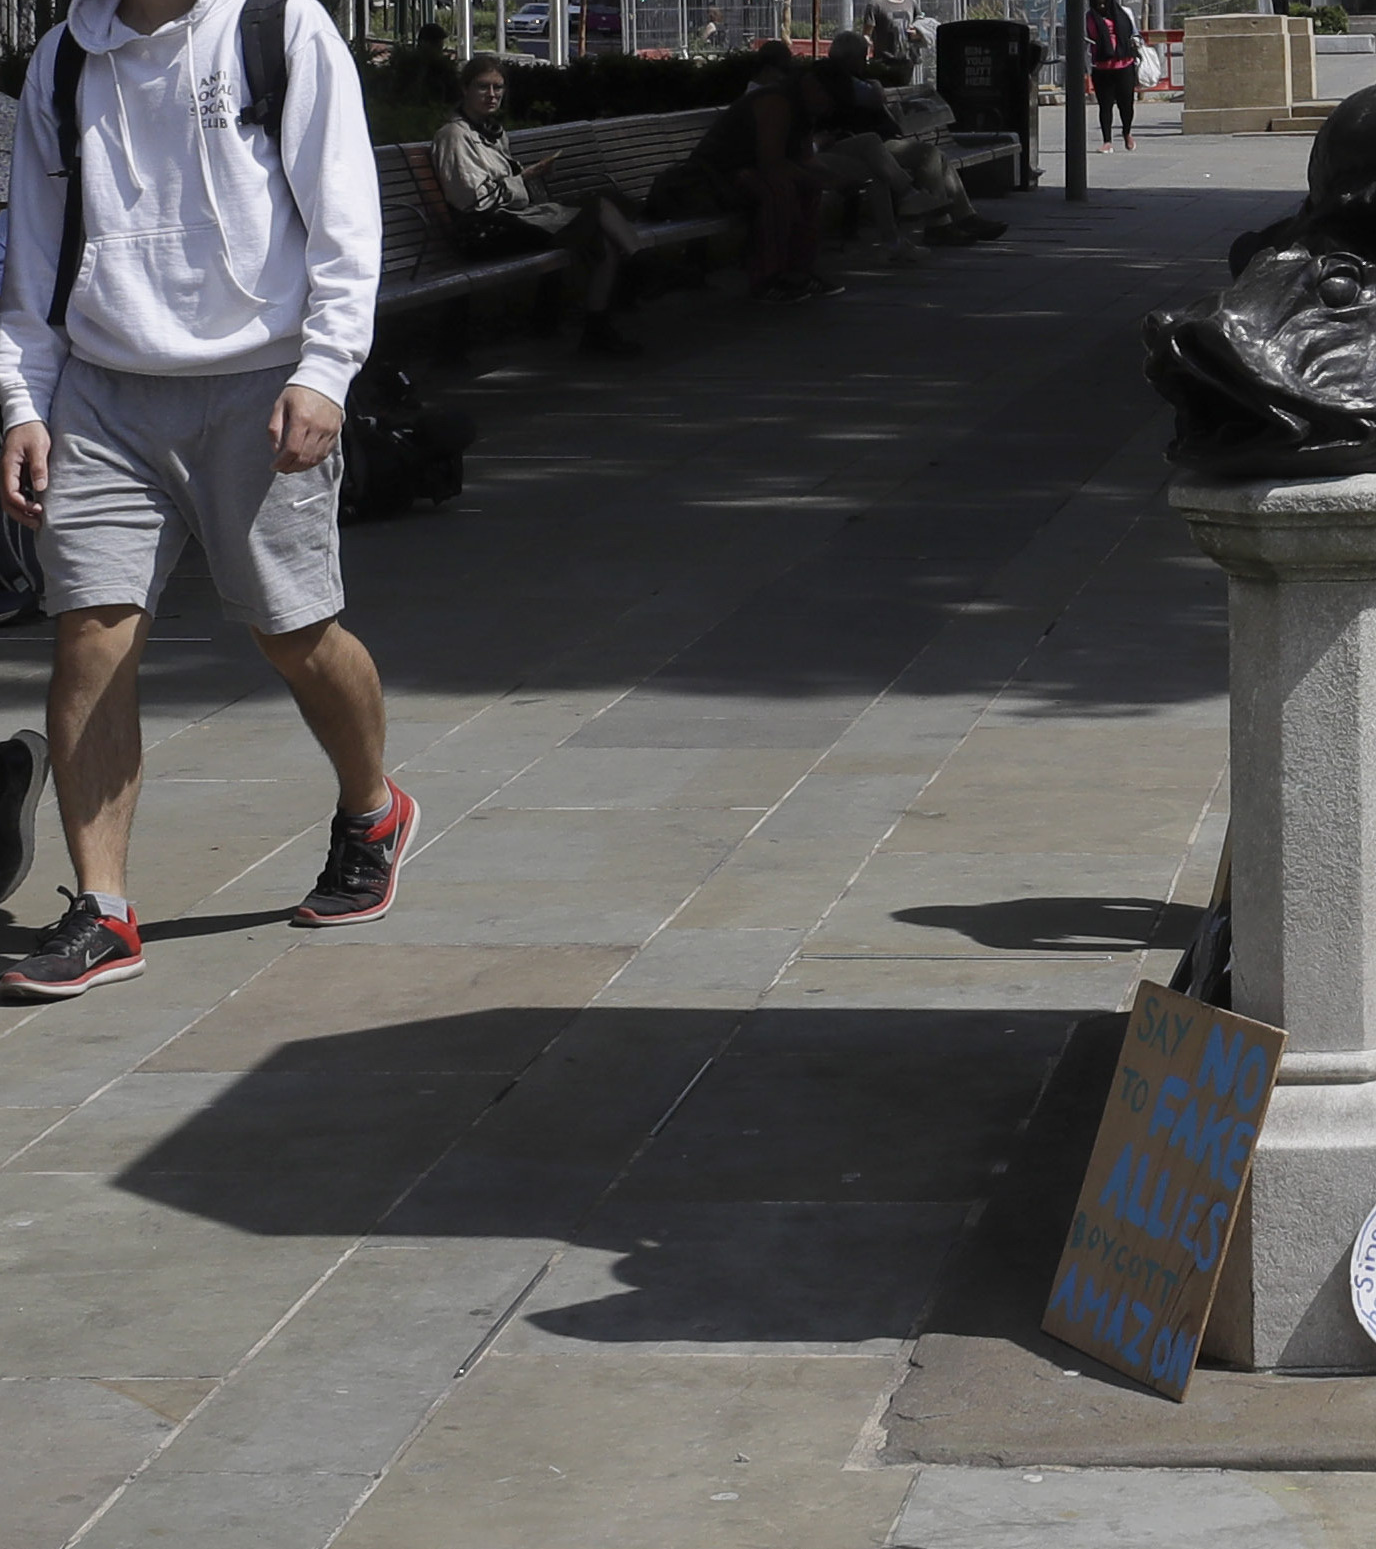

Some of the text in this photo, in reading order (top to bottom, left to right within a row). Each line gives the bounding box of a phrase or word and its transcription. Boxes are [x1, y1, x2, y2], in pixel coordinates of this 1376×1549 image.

[199, 70, 227, 89] ANTI
[1136, 994, 1268, 1114] SAY NO
[1120, 1065, 1259, 1192] TO FAKE
[1069, 1209, 1179, 1308] BOYCOTT
[1098, 1141, 1229, 1273] ALLIES
[1048, 1260, 1198, 1391] AMAZON
